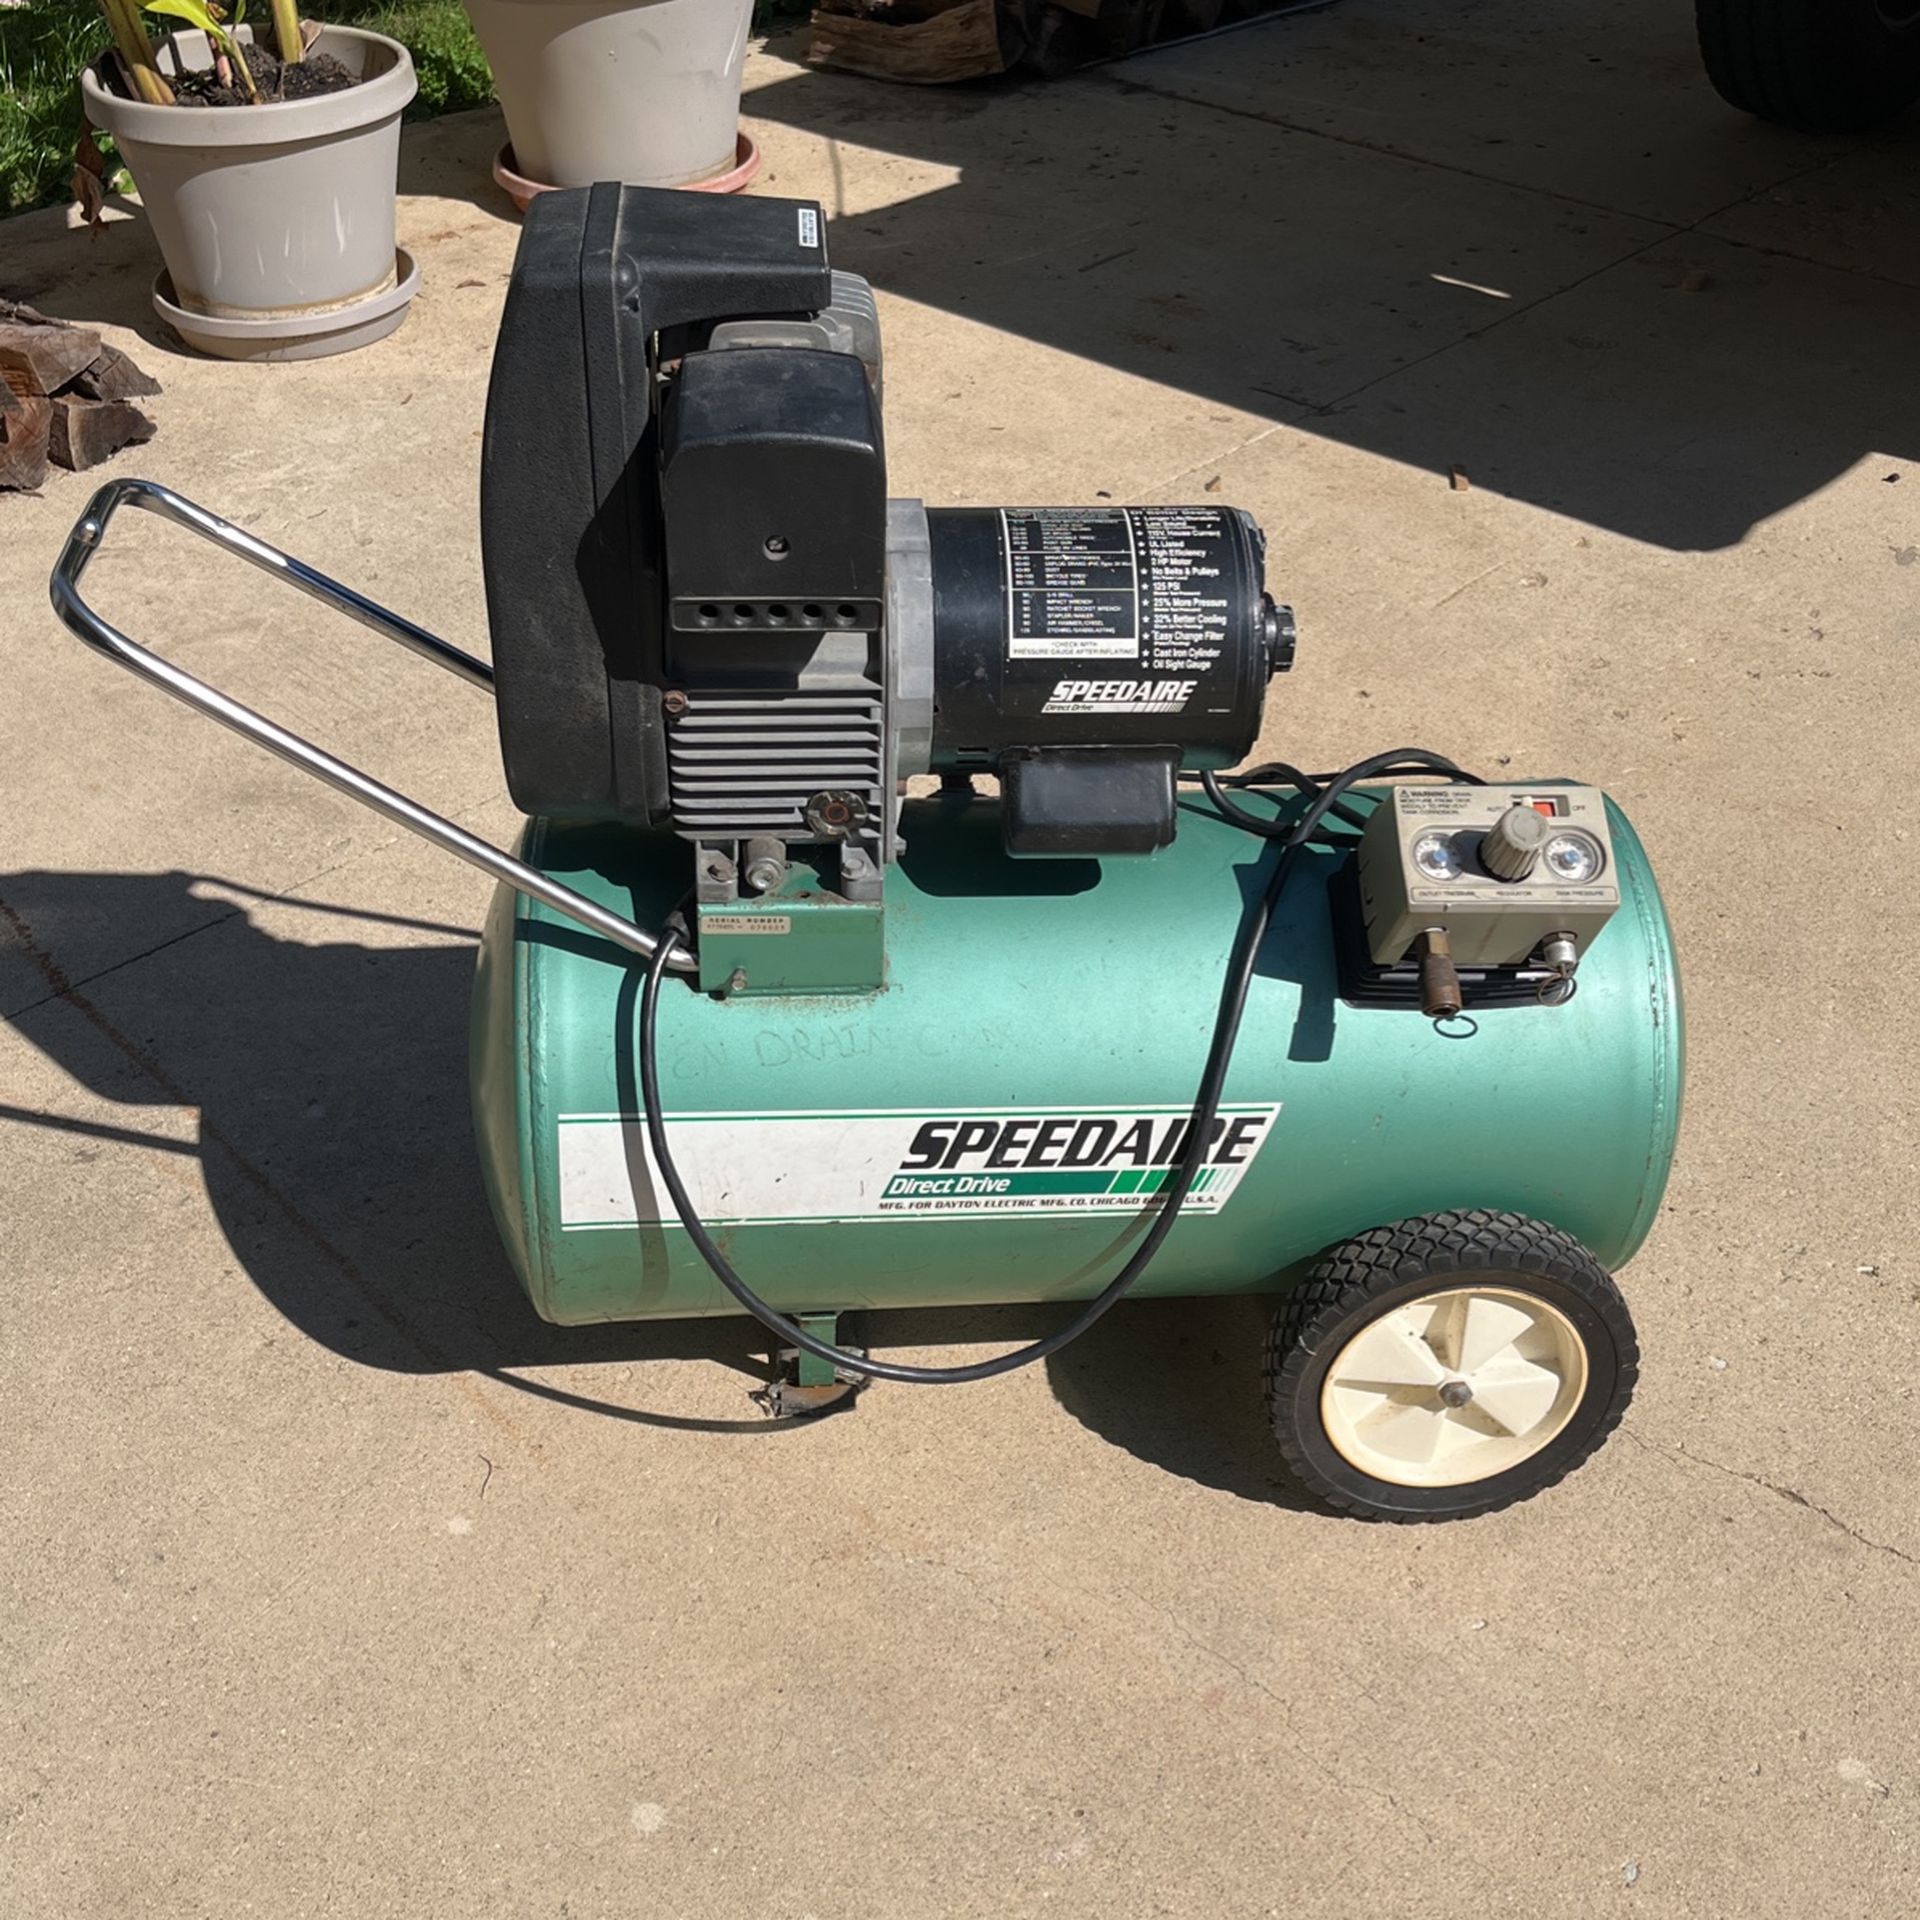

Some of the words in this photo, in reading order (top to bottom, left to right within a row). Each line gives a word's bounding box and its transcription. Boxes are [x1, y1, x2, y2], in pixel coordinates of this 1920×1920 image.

[1192, 530, 1221, 538] Current
[1148, 540, 1161, 548] UL
[1160, 540, 1185, 548] Listed
[1149, 549, 1168, 558] High
[1168, 549, 1207, 559] Efficiency
[1150, 557, 1157, 566] 2
[1157, 558, 1169, 566] HP
[1169, 557, 1193, 566] Motor
[1151, 567, 1163, 576] No
[1164, 567, 1183, 576] Belts
[1184, 567, 1191, 576] &
[1191, 567, 1220, 578] Pulleys
[1152, 582, 1167, 591] 125
[1167, 582, 1181, 591] PSI
[1153, 597, 1172, 607] 25%
[1172, 597, 1192, 607] More
[1192, 597, 1228, 607] Pressure
[1172, 614, 1197, 624] Better
[1197, 614, 1228, 626] Cooling
[1174, 631, 1204, 643] Change
[1204, 631, 1225, 641] Filter
[1153, 648, 1172, 658] Cast
[1172, 648, 1188, 657] Iron
[1188, 647, 1221, 659] Cylinder
[1152, 659, 1165, 669] Oil
[1165, 659, 1185, 671] Sight
[1185, 659, 1212, 671] Gauge
[1049, 680, 1198, 702] SPEEDAIRE
[1044, 703, 1071, 712] Direct
[1071, 703, 1095, 712] Drive
[1571, 804, 1586, 812] OFF
[753, 1021, 882, 1068] DRAIN
[899, 1115, 1267, 1171] SPEEDAIRE
[887, 1177, 956, 1195] Direct
[953, 1176, 1012, 1193] Drive
[878, 1201, 906, 1210] MFG.
[908, 1201, 932, 1210] FOR
[934, 1200, 982, 1209] DAYTON
[984, 1199, 1036, 1209] ELECTRIC
[1039, 1198, 1068, 1207] MFG.
[1069, 1198, 1088, 1207] CO.
[1090, 1196, 1140, 1206] CHICAGO
